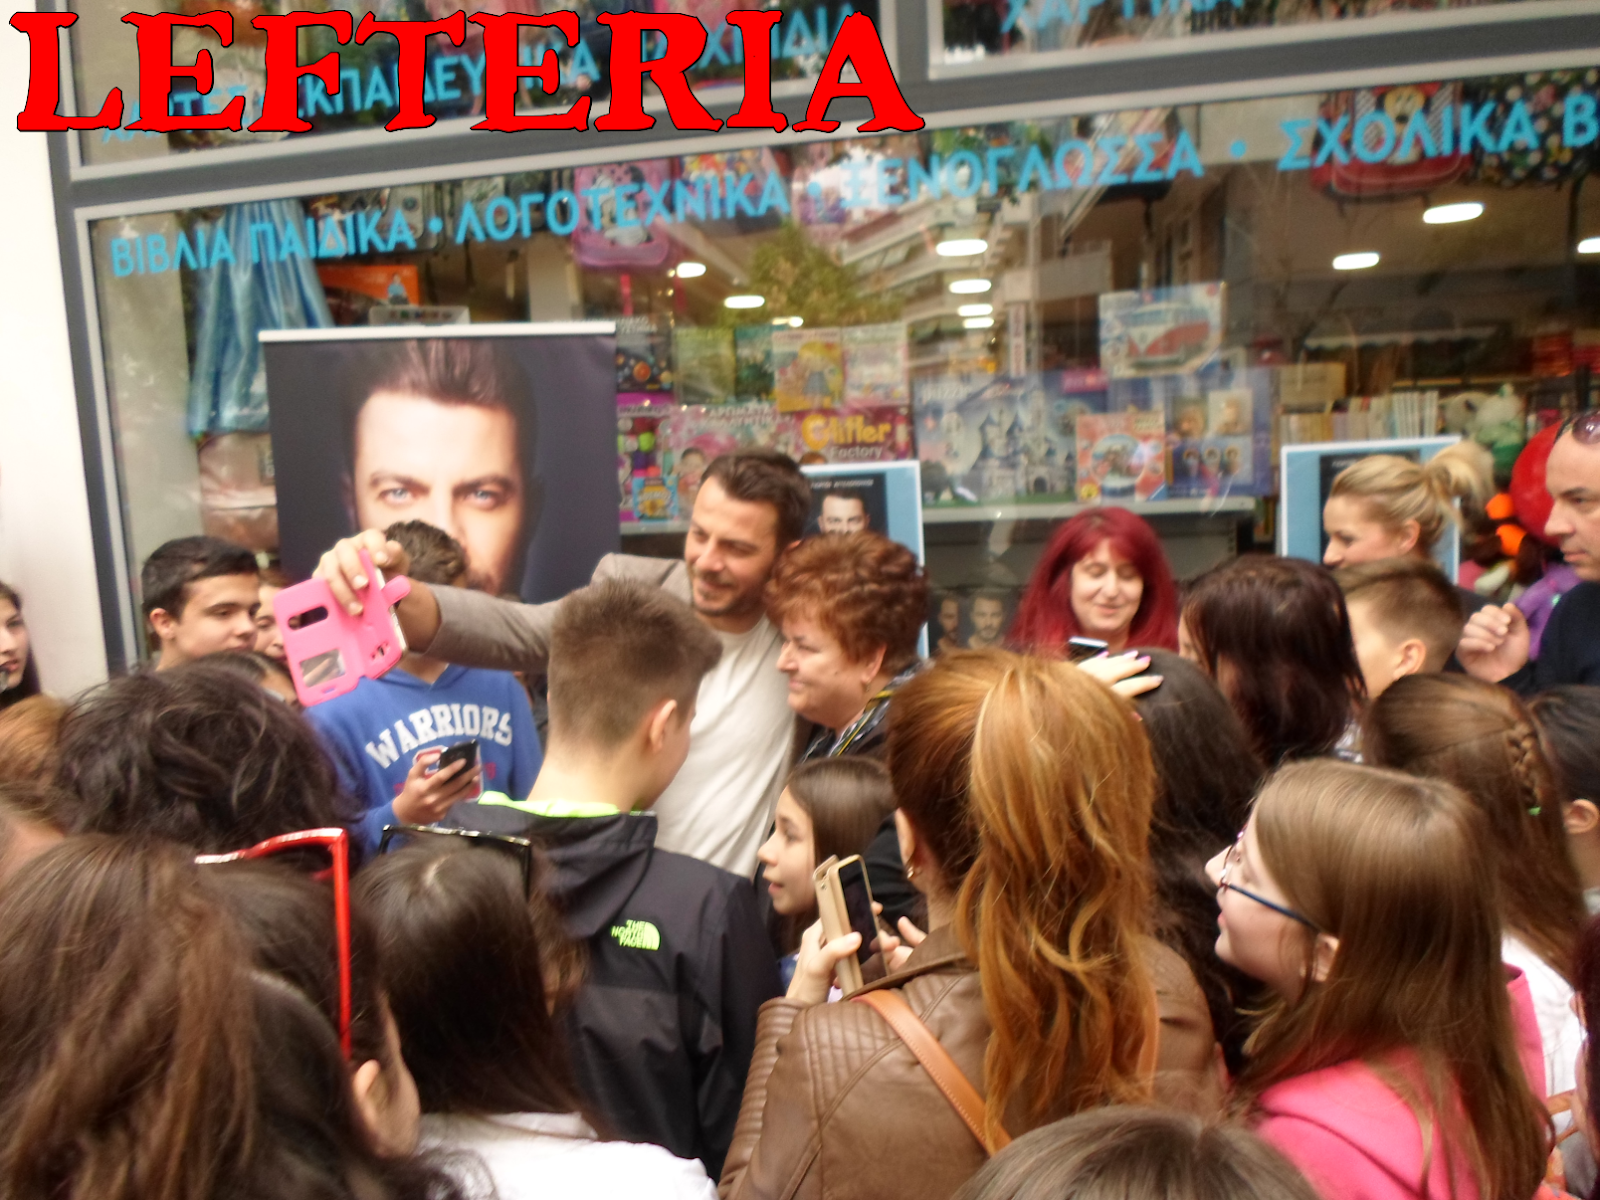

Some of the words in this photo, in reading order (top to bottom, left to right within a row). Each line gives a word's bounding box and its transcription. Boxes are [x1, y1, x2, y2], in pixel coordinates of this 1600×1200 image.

[111, 226, 237, 277] ΒΙΒΛΙΑ
[249, 209, 417, 264] ΠΑΙΔΙΚΑ
[455, 170, 790, 244] ΛΟΓΟΤΕΧΝΙΚΑ
[839, 130, 1204, 208] ΞΕΝΟΓΛΩΣΣΑ
[1277, 99, 1540, 171] ΣΧΟΛΙΚΑ
[802, 414, 892, 450] Glitter
[830, 445, 883, 459] Factory
[365, 703, 513, 768] WARRIORS
[626, 919, 645, 931] THE
